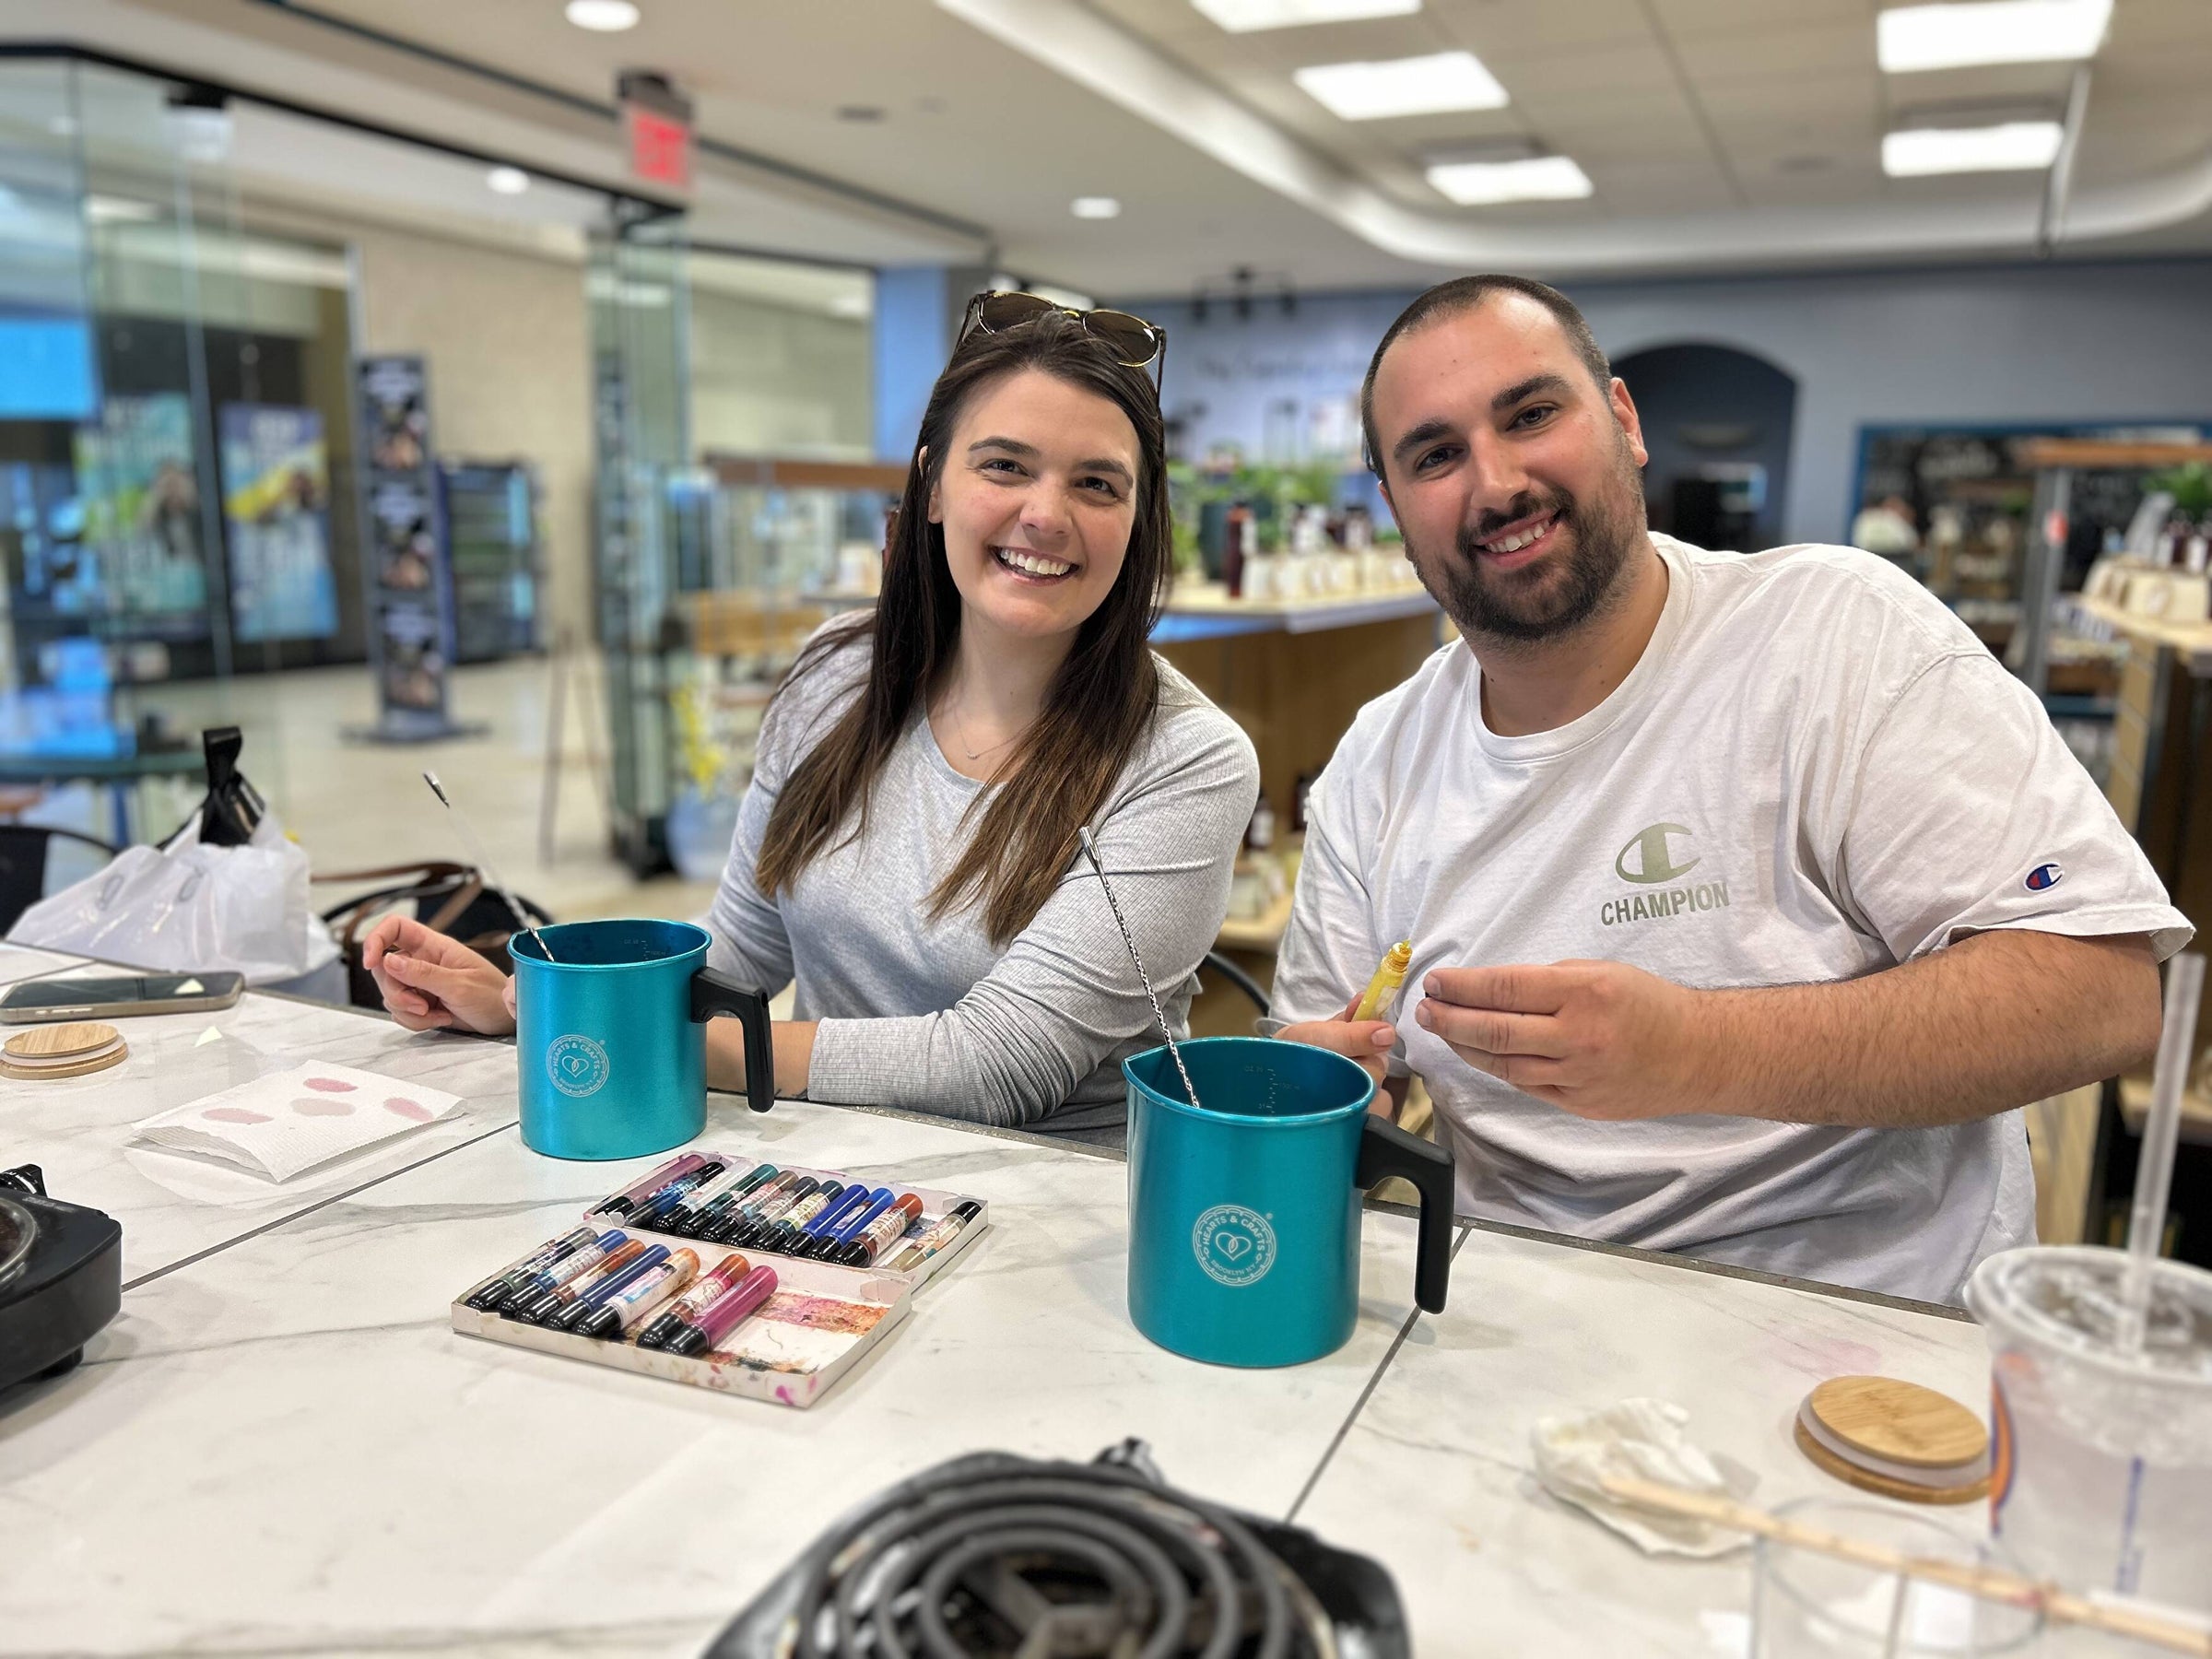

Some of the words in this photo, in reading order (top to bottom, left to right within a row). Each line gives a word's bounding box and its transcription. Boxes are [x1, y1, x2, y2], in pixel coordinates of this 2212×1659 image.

[1601, 882, 1730, 925] CHAMPION
[553, 1042, 570, 1066] HEARTS
[580, 1044, 600, 1069] CRAFTS
[1203, 1216, 1228, 1245] HEARTS
[1230, 1215, 1238, 1223] &
[1241, 1218, 1265, 1252] CRAFTS
[1210, 1259, 1245, 1276] BROOKLYN
